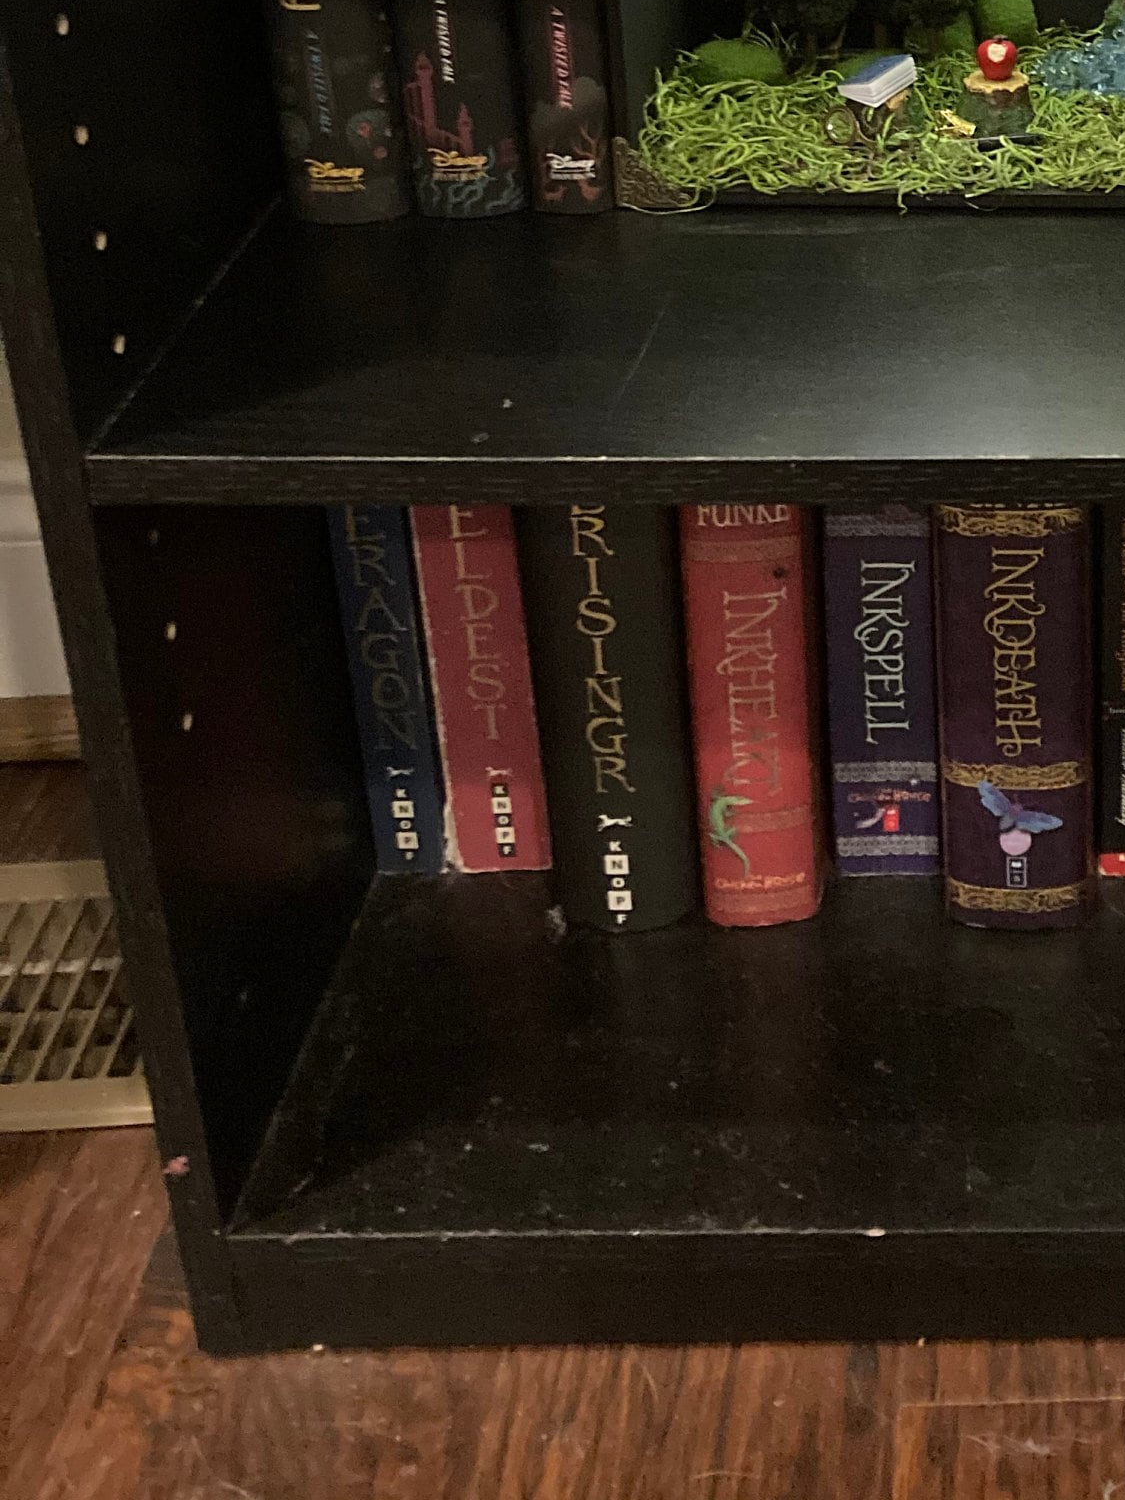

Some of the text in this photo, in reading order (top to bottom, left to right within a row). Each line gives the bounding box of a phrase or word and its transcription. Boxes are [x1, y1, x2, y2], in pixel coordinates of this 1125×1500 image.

[570, 505, 637, 793] RISINGR
[853, 559, 916, 746] INKSPELL
[983, 546, 1046, 758] INKDEATH
[604, 840, 634, 925] KNOPF
